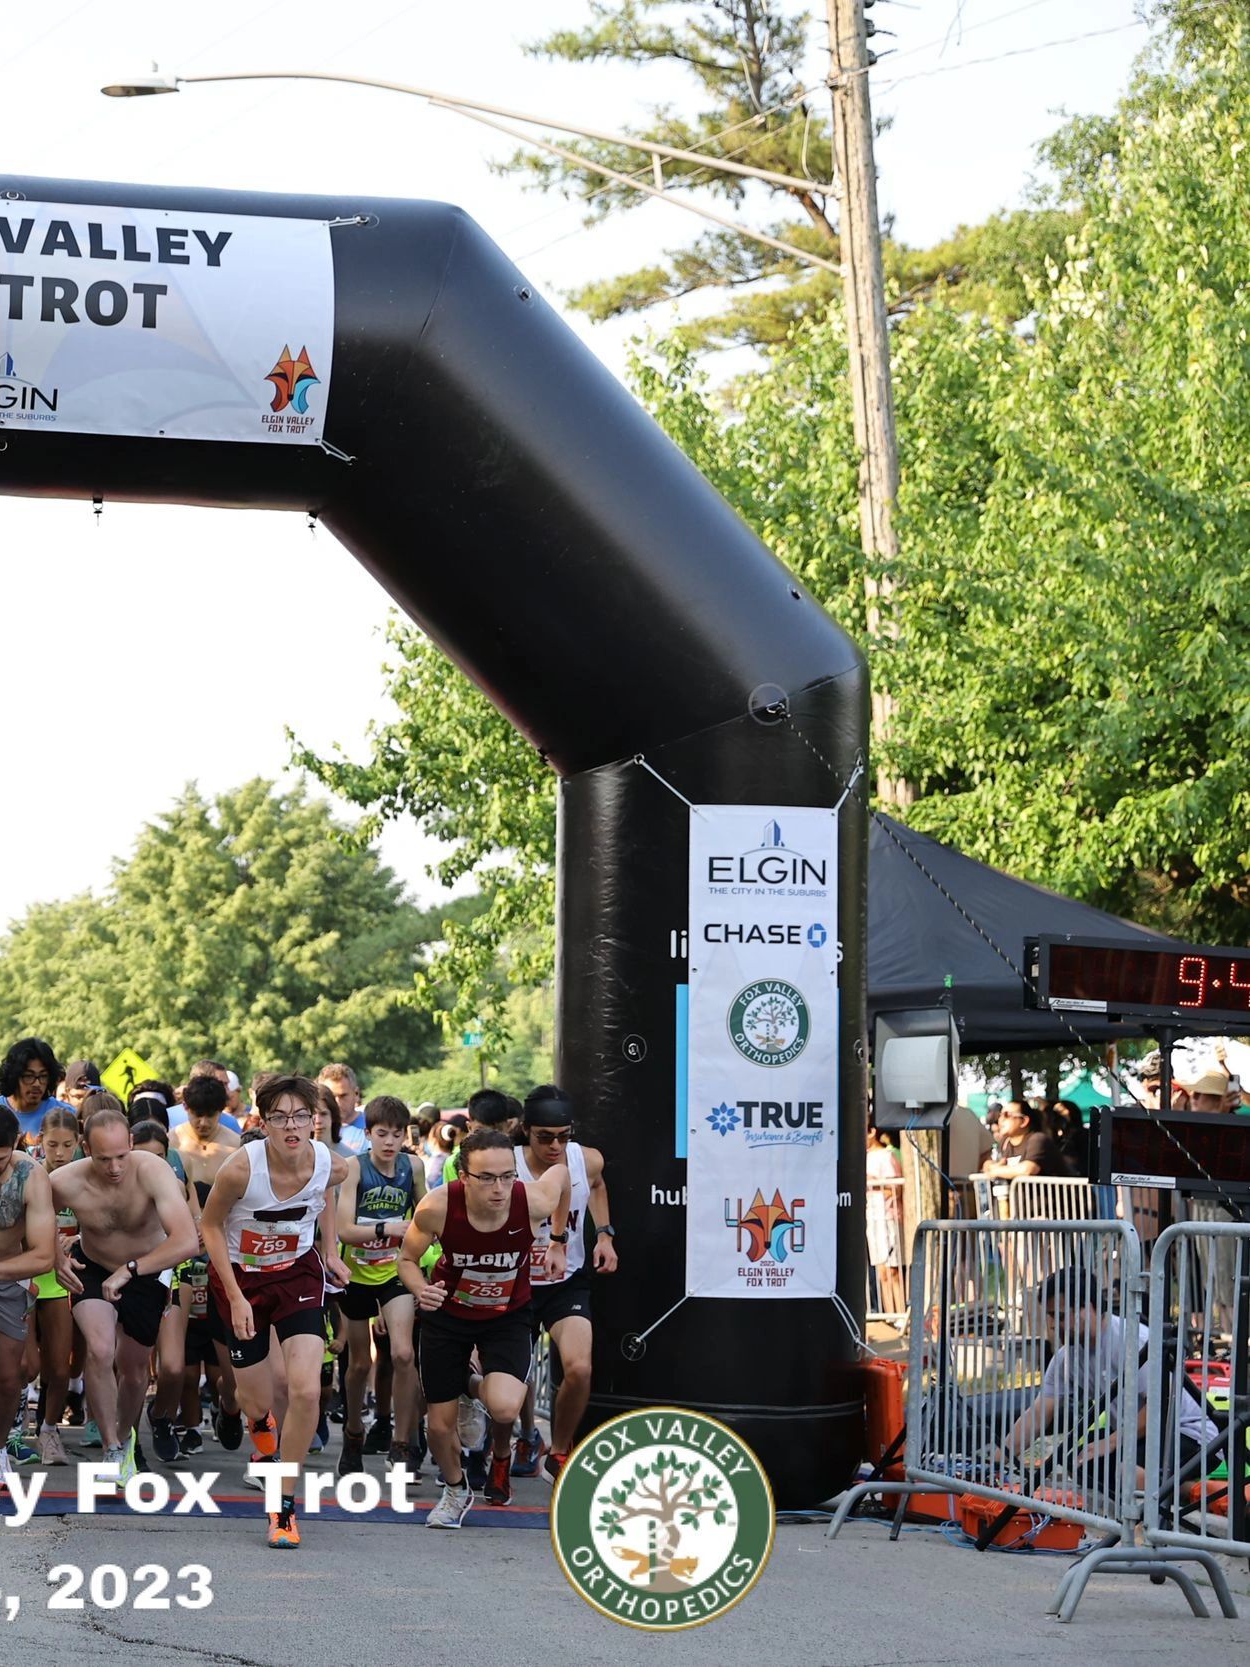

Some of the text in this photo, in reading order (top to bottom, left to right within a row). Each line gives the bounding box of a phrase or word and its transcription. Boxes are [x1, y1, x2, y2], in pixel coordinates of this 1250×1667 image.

[0, 273, 168, 328] TROT
[16, 413, 57, 421] SUBURBS
[261, 414, 315, 425] ELGIN VALLEY
[268, 424, 306, 433] FOX TROT
[708, 856, 826, 886] ELGIN
[708, 887, 728, 895] THE
[731, 887, 751, 895] CITY
[768, 888, 785, 896] THE
[788, 888, 827, 897] SUBURBS
[704, 923, 802, 944] CHASE
[739, 982, 803, 1007] FOX VALLEY
[734, 1033, 805, 1064] ORTHOPEDICS
[736, 1101, 823, 1128] TRUE
[743, 1129, 823, 1146] Insurance & Benefits
[367, 1202, 399, 1212] SHARKS
[251, 1239, 287, 1254] 759
[452, 1251, 520, 1269] ELGIN
[737, 1267, 795, 1277] ELGIN VALLEY
[746, 1277, 787, 1287] FOX TROT
[469, 1284, 503, 1297] 753
